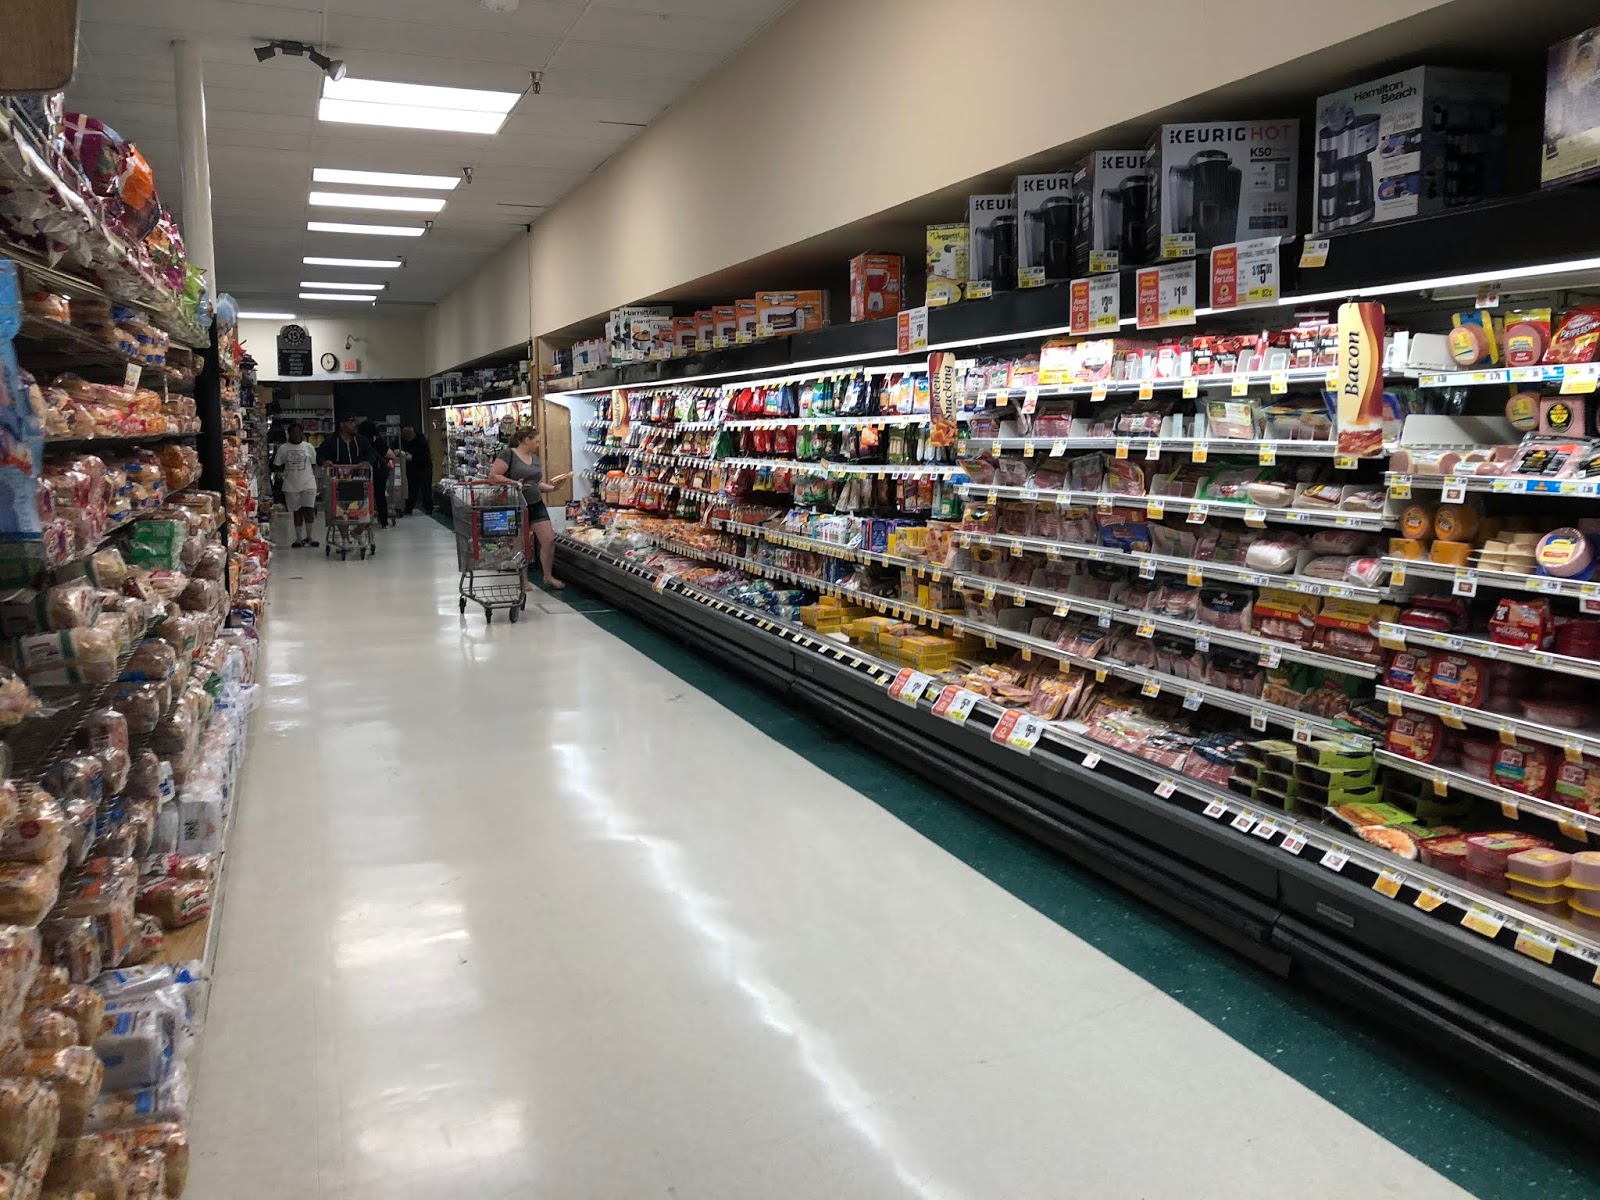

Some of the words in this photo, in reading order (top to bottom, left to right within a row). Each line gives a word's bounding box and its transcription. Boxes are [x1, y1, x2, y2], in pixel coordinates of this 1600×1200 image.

[1354, 80, 1404, 102] Hamilton
[1381, 86, 1417, 104] Beach
[1170, 127, 1246, 144] KEURIG
[1251, 125, 1291, 141] HOT
[1250, 147, 1272, 157] K50
[1344, 331, 1360, 398] Bacon
[931, 371, 941, 416] Protein
[943, 365, 953, 421] Snacking
